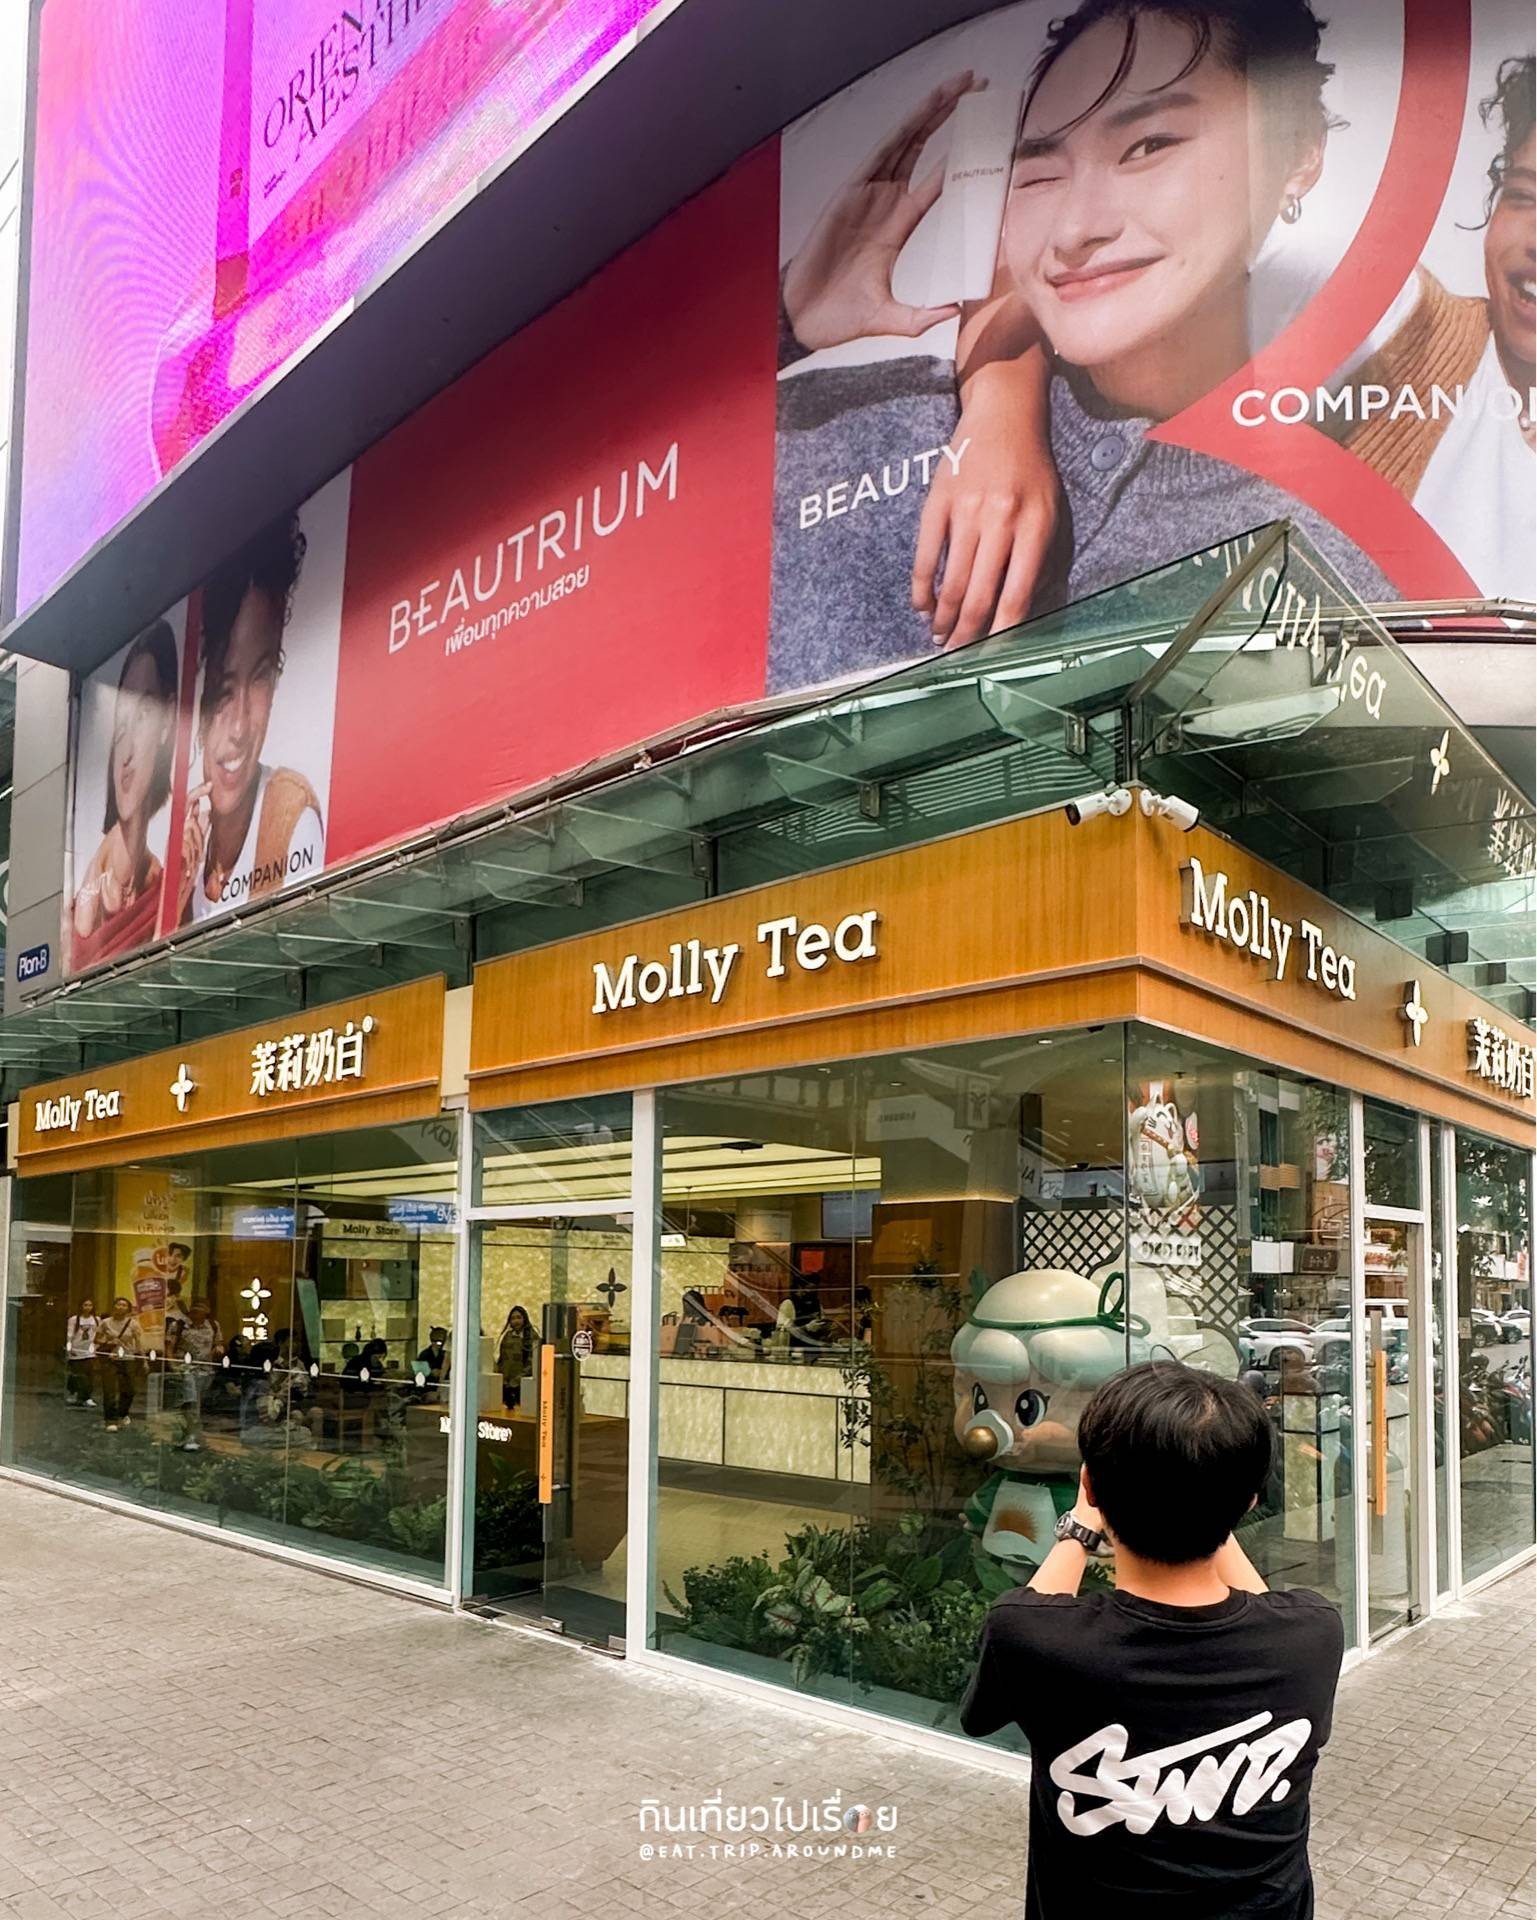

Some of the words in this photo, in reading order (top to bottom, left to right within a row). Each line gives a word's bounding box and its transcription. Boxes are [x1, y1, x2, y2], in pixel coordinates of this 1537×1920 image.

[264, 0, 381, 148] ORIEN
[799, 438, 971, 530] BEAUTY
[388, 442, 678, 654] BEAUTRIUM
[445, 564, 590, 656] เพื่อนทุกความสวย
[220, 845, 314, 902] COMPANION
[591, 938, 740, 1015] Molly
[757, 910, 879, 978] Tea
[1189, 857, 1293, 981] Molly
[1301, 919, 1356, 1001] Tea
[250, 1021, 366, 1097] 茉莉奶白
[34, 1095, 81, 1132] Molly
[84, 1088, 121, 1121] Tea
[343, 1223, 371, 1236] Molly
